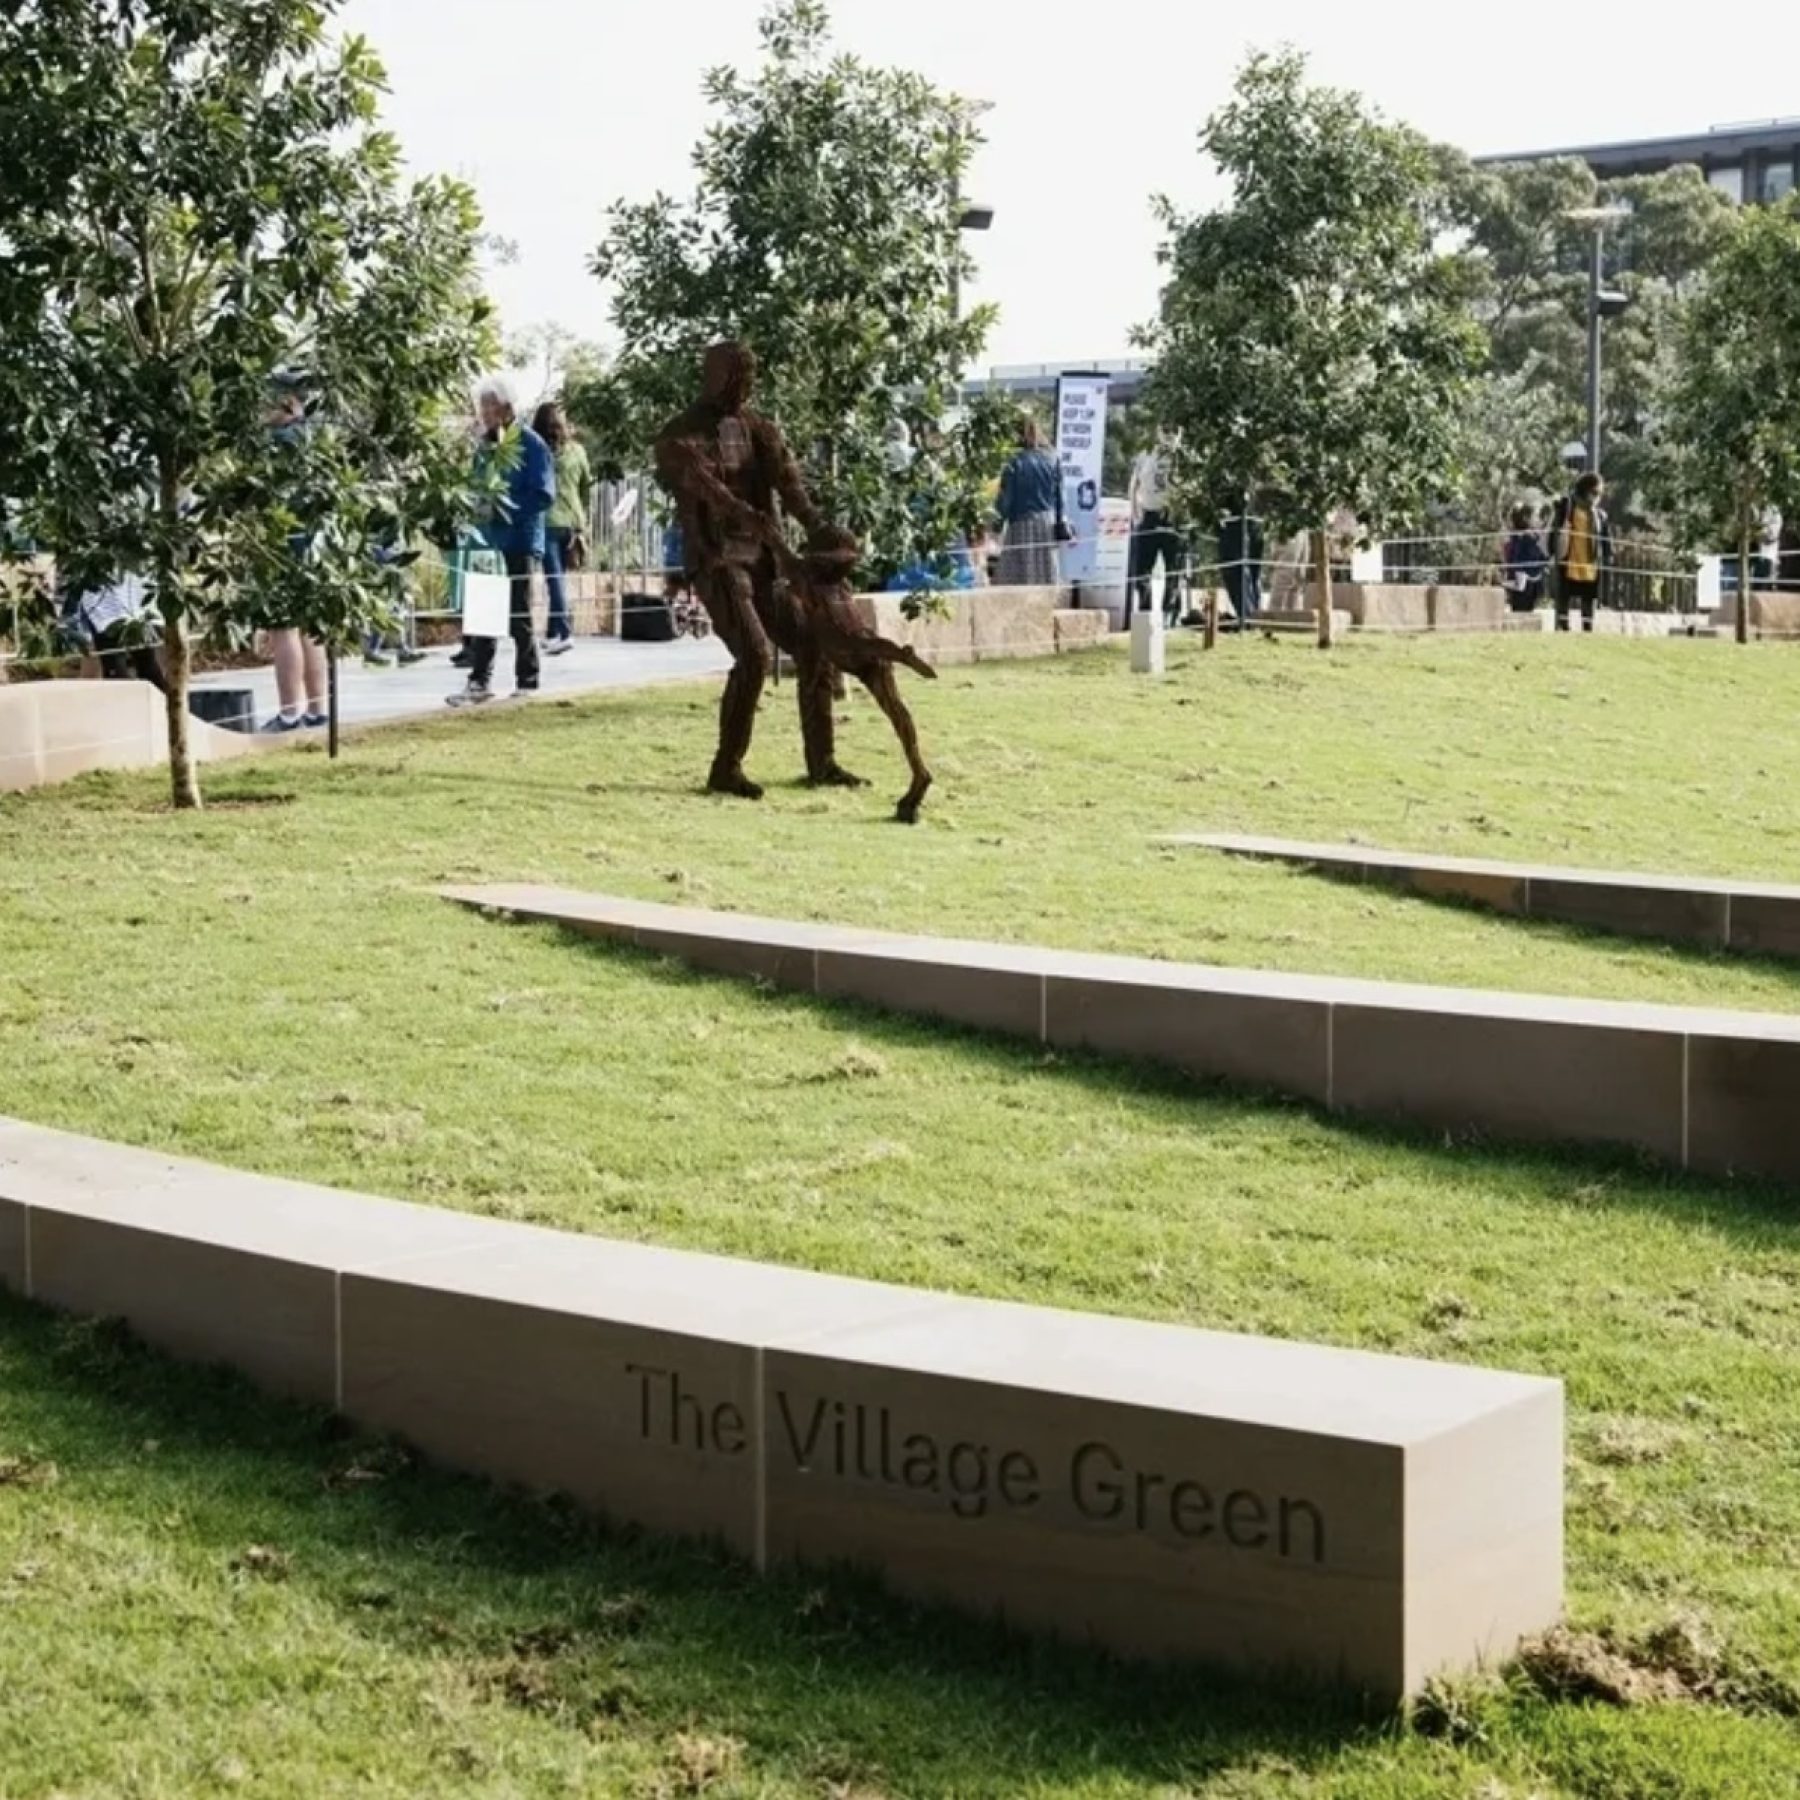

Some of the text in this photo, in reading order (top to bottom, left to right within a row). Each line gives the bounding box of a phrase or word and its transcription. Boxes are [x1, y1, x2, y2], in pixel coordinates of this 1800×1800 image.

[625, 1362, 1325, 1563] The Village Green
